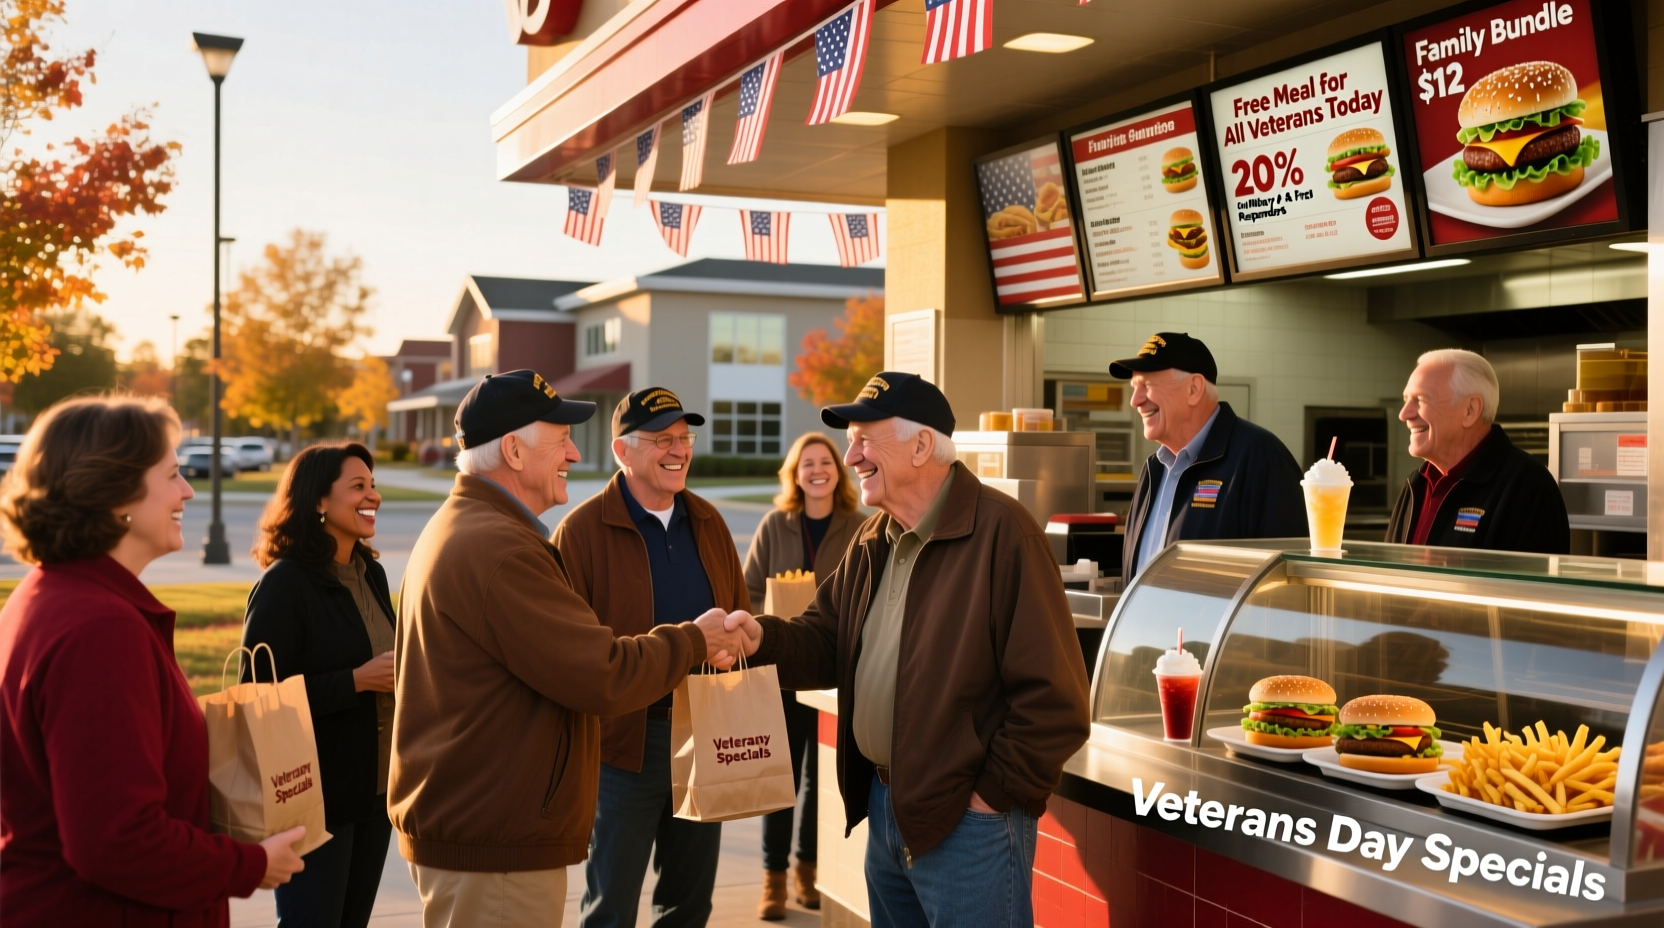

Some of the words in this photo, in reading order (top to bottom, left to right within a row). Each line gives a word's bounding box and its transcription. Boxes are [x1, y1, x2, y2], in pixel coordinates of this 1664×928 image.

[1415, 26, 1485, 66] Family
[1490, 1, 1573, 45] Bundle
[1233, 97, 1270, 118] Free
[1273, 76, 1315, 108] Meal
[1319, 72, 1347, 94] for
[1417, 62, 1465, 105] $12
[1224, 121, 1245, 147] All
[1247, 106, 1324, 140] Veterans
[1325, 90, 1383, 119] Today
[1231, 148, 1304, 197] 20%
[1131, 777, 1317, 847] Veterans
[1327, 814, 1414, 872] Day
[1421, 833, 1607, 902] Specials
